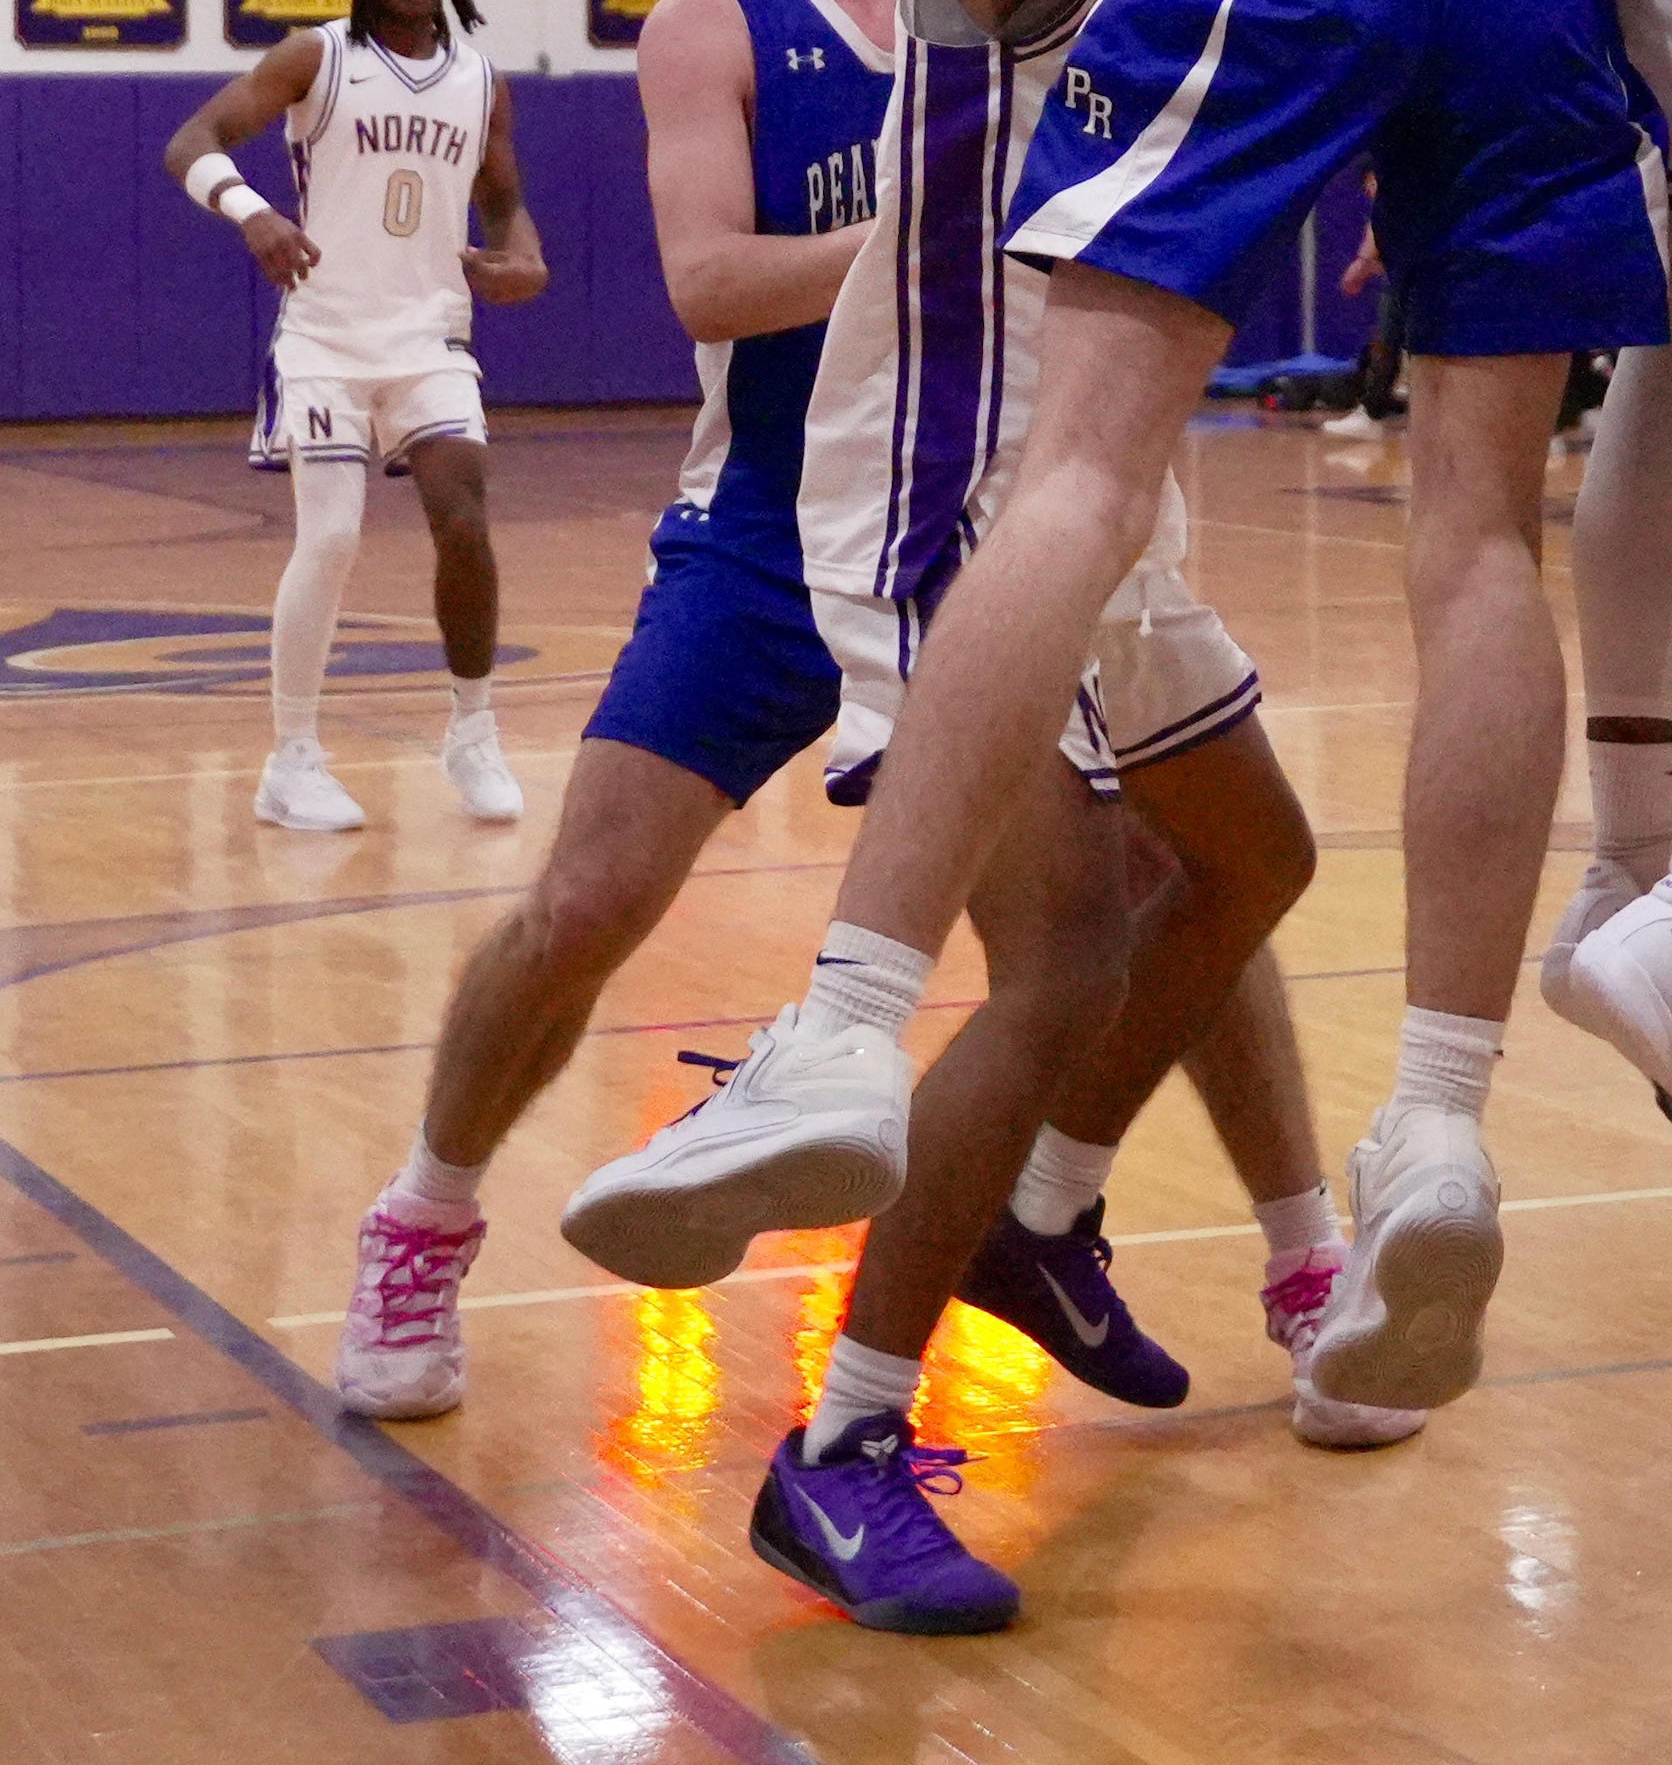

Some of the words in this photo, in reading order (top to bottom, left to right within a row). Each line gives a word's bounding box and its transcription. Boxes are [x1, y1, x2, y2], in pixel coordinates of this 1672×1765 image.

[1065, 65, 1114, 140] PR
[354, 112, 468, 166] NORTH
[382, 168, 425, 237] 0
[308, 405, 333, 439] N
